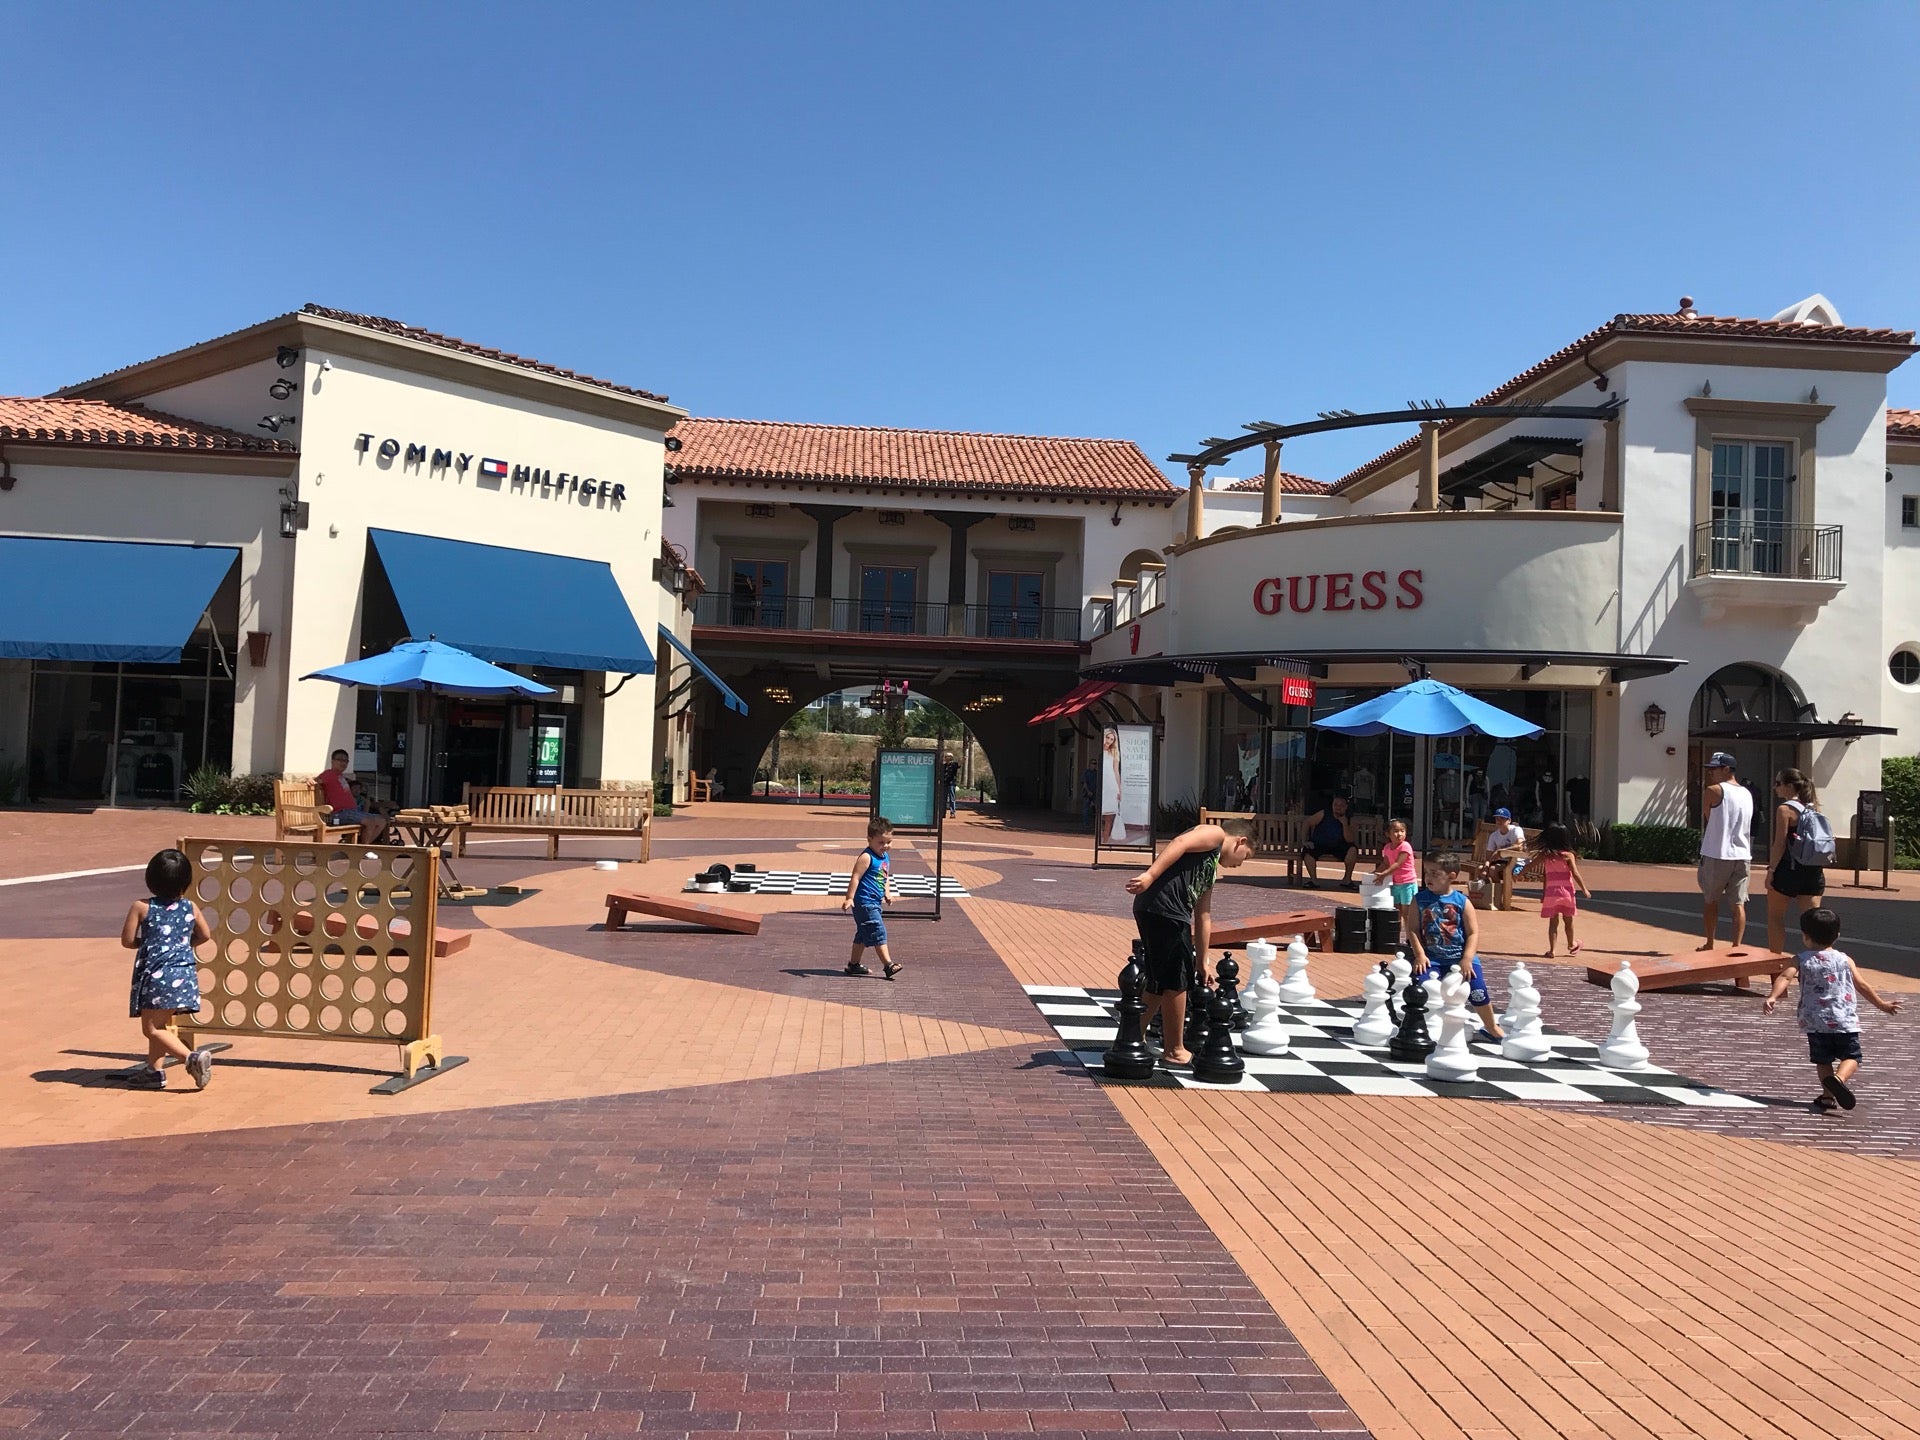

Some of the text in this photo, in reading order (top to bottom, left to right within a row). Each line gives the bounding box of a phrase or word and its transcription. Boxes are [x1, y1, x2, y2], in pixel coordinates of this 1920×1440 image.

[358, 432, 627, 501] TOMMY HILFIGER
[1252, 569, 1424, 616] GUESS
[1288, 685, 1313, 699] GUESS
[881, 755, 934, 766] GAME RULES
